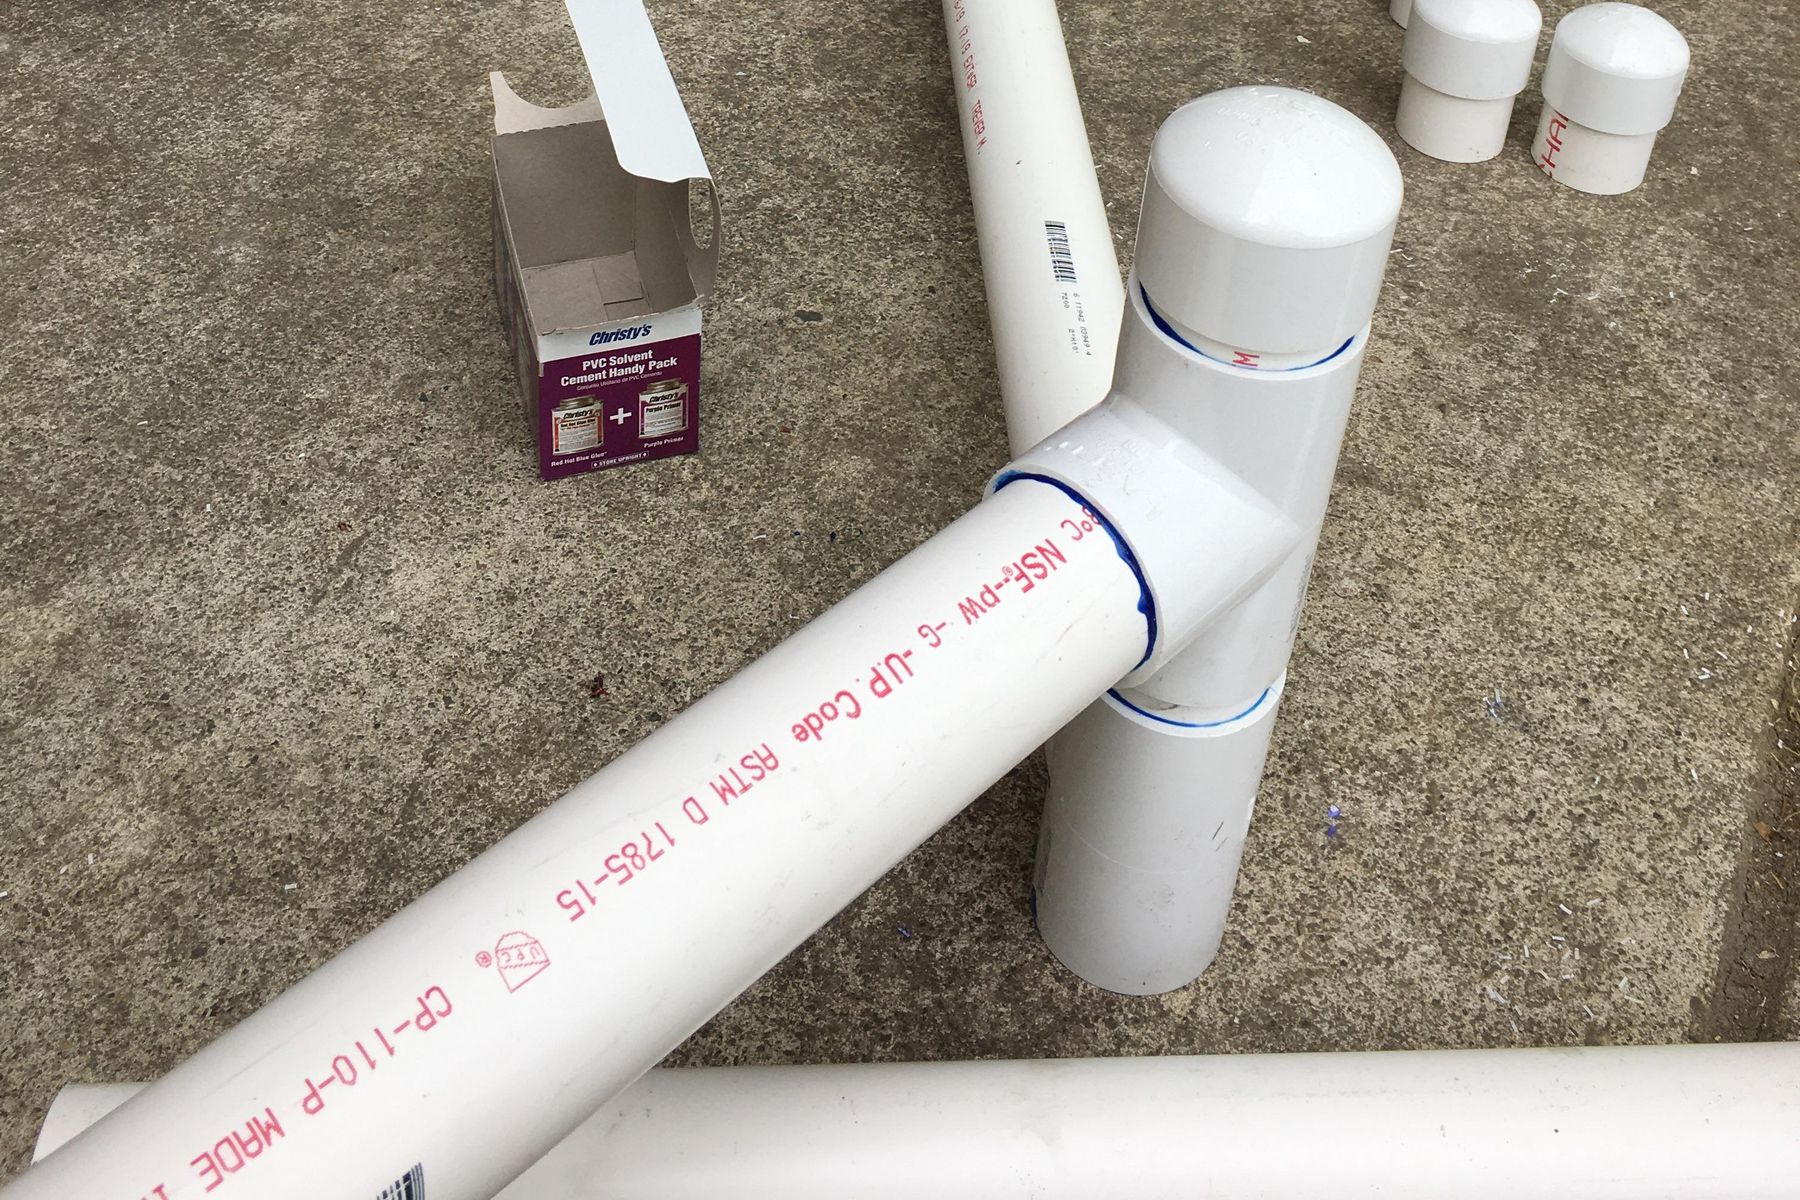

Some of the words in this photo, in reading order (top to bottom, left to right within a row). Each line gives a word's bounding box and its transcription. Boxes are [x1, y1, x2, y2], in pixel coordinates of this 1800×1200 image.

[589, 324, 652, 346] Christy's
[560, 370, 606, 386] Cement
[609, 363, 645, 378] Handy
[648, 357, 677, 370] Pack
[582, 357, 607, 371] PVC
[609, 349, 653, 366] Solvent
[551, 458, 563, 467] Red
[564, 456, 575, 464] Hot
[792, 690, 862, 742] Code
[709, 743, 779, 806] ASTM
[682, 796, 709, 825] D
[556, 822, 675, 922] 1785-15
[302, 986, 452, 1115] CP-110-P
[190, 1107, 286, 1193] MADE
